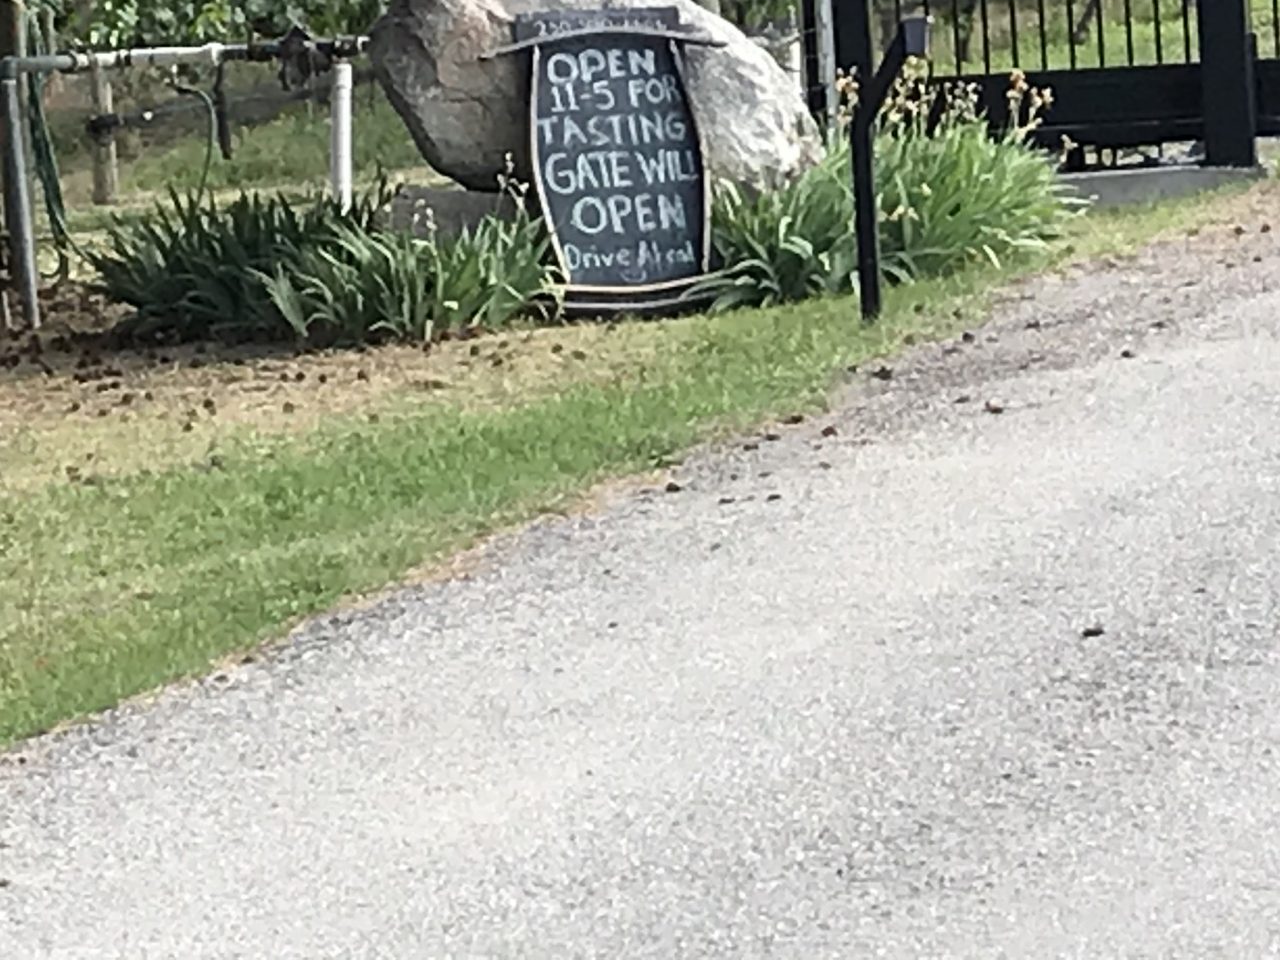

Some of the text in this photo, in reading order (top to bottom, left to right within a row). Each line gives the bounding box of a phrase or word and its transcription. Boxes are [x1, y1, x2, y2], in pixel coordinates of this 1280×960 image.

[547, 49, 655, 83] OPEN
[551, 74, 681, 112] 11-5 FOR
[537, 111, 686, 146] TASTING
[545, 149, 698, 194] GATE WILL
[570, 193, 687, 234] OPEN
[564, 243, 630, 270] Drive
